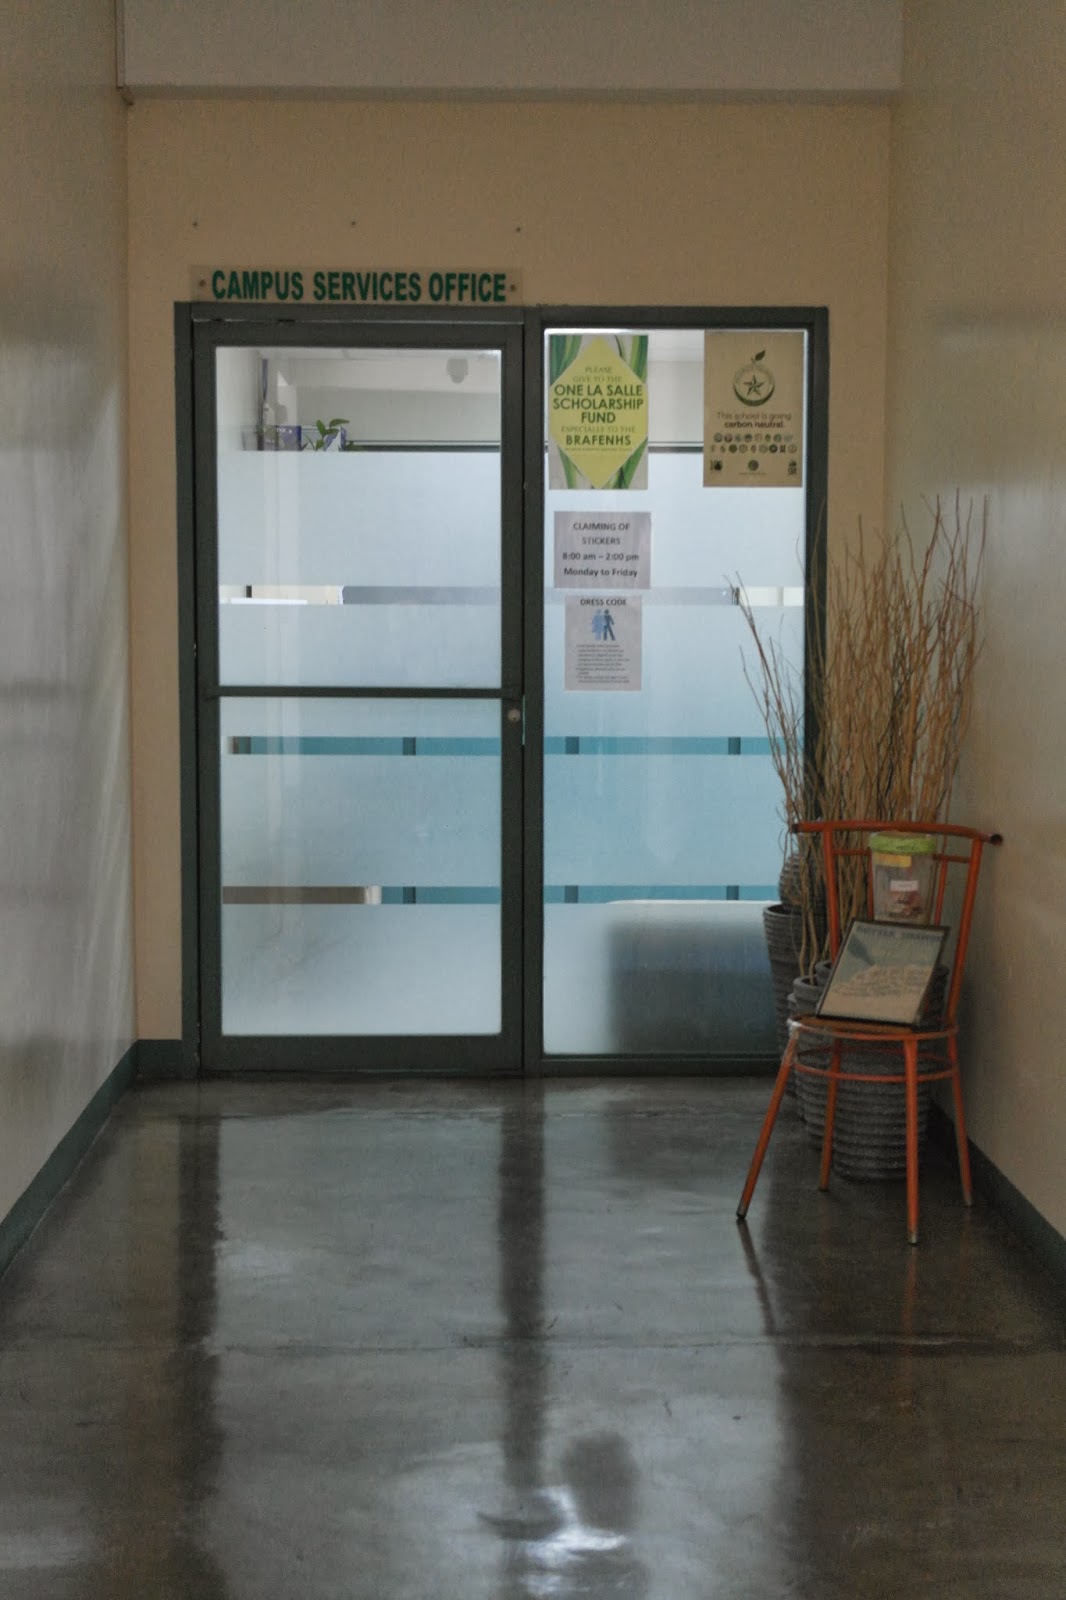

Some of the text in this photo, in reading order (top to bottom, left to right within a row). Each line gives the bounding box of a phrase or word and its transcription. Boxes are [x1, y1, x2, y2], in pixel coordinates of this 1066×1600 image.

[212, 269, 507, 302] CAMPUS SERVICES OFFICE
[585, 366, 613, 374] PLEASE
[554, 384, 643, 396] ONE LA SALLE
[553, 398, 644, 410] SCHOLARSHIP
[581, 411, 616, 423] FUND
[566, 435, 631, 446] BRAFENHS
[573, 522, 630, 531] CLAIMING OF
[582, 537, 621, 545] STICKERS
[562, 552, 581, 560] 8:00
[626, 554, 640, 562] pm
[563, 567, 638, 578] Monday to Friday
[580, 598, 626, 606] DRESS CODE
